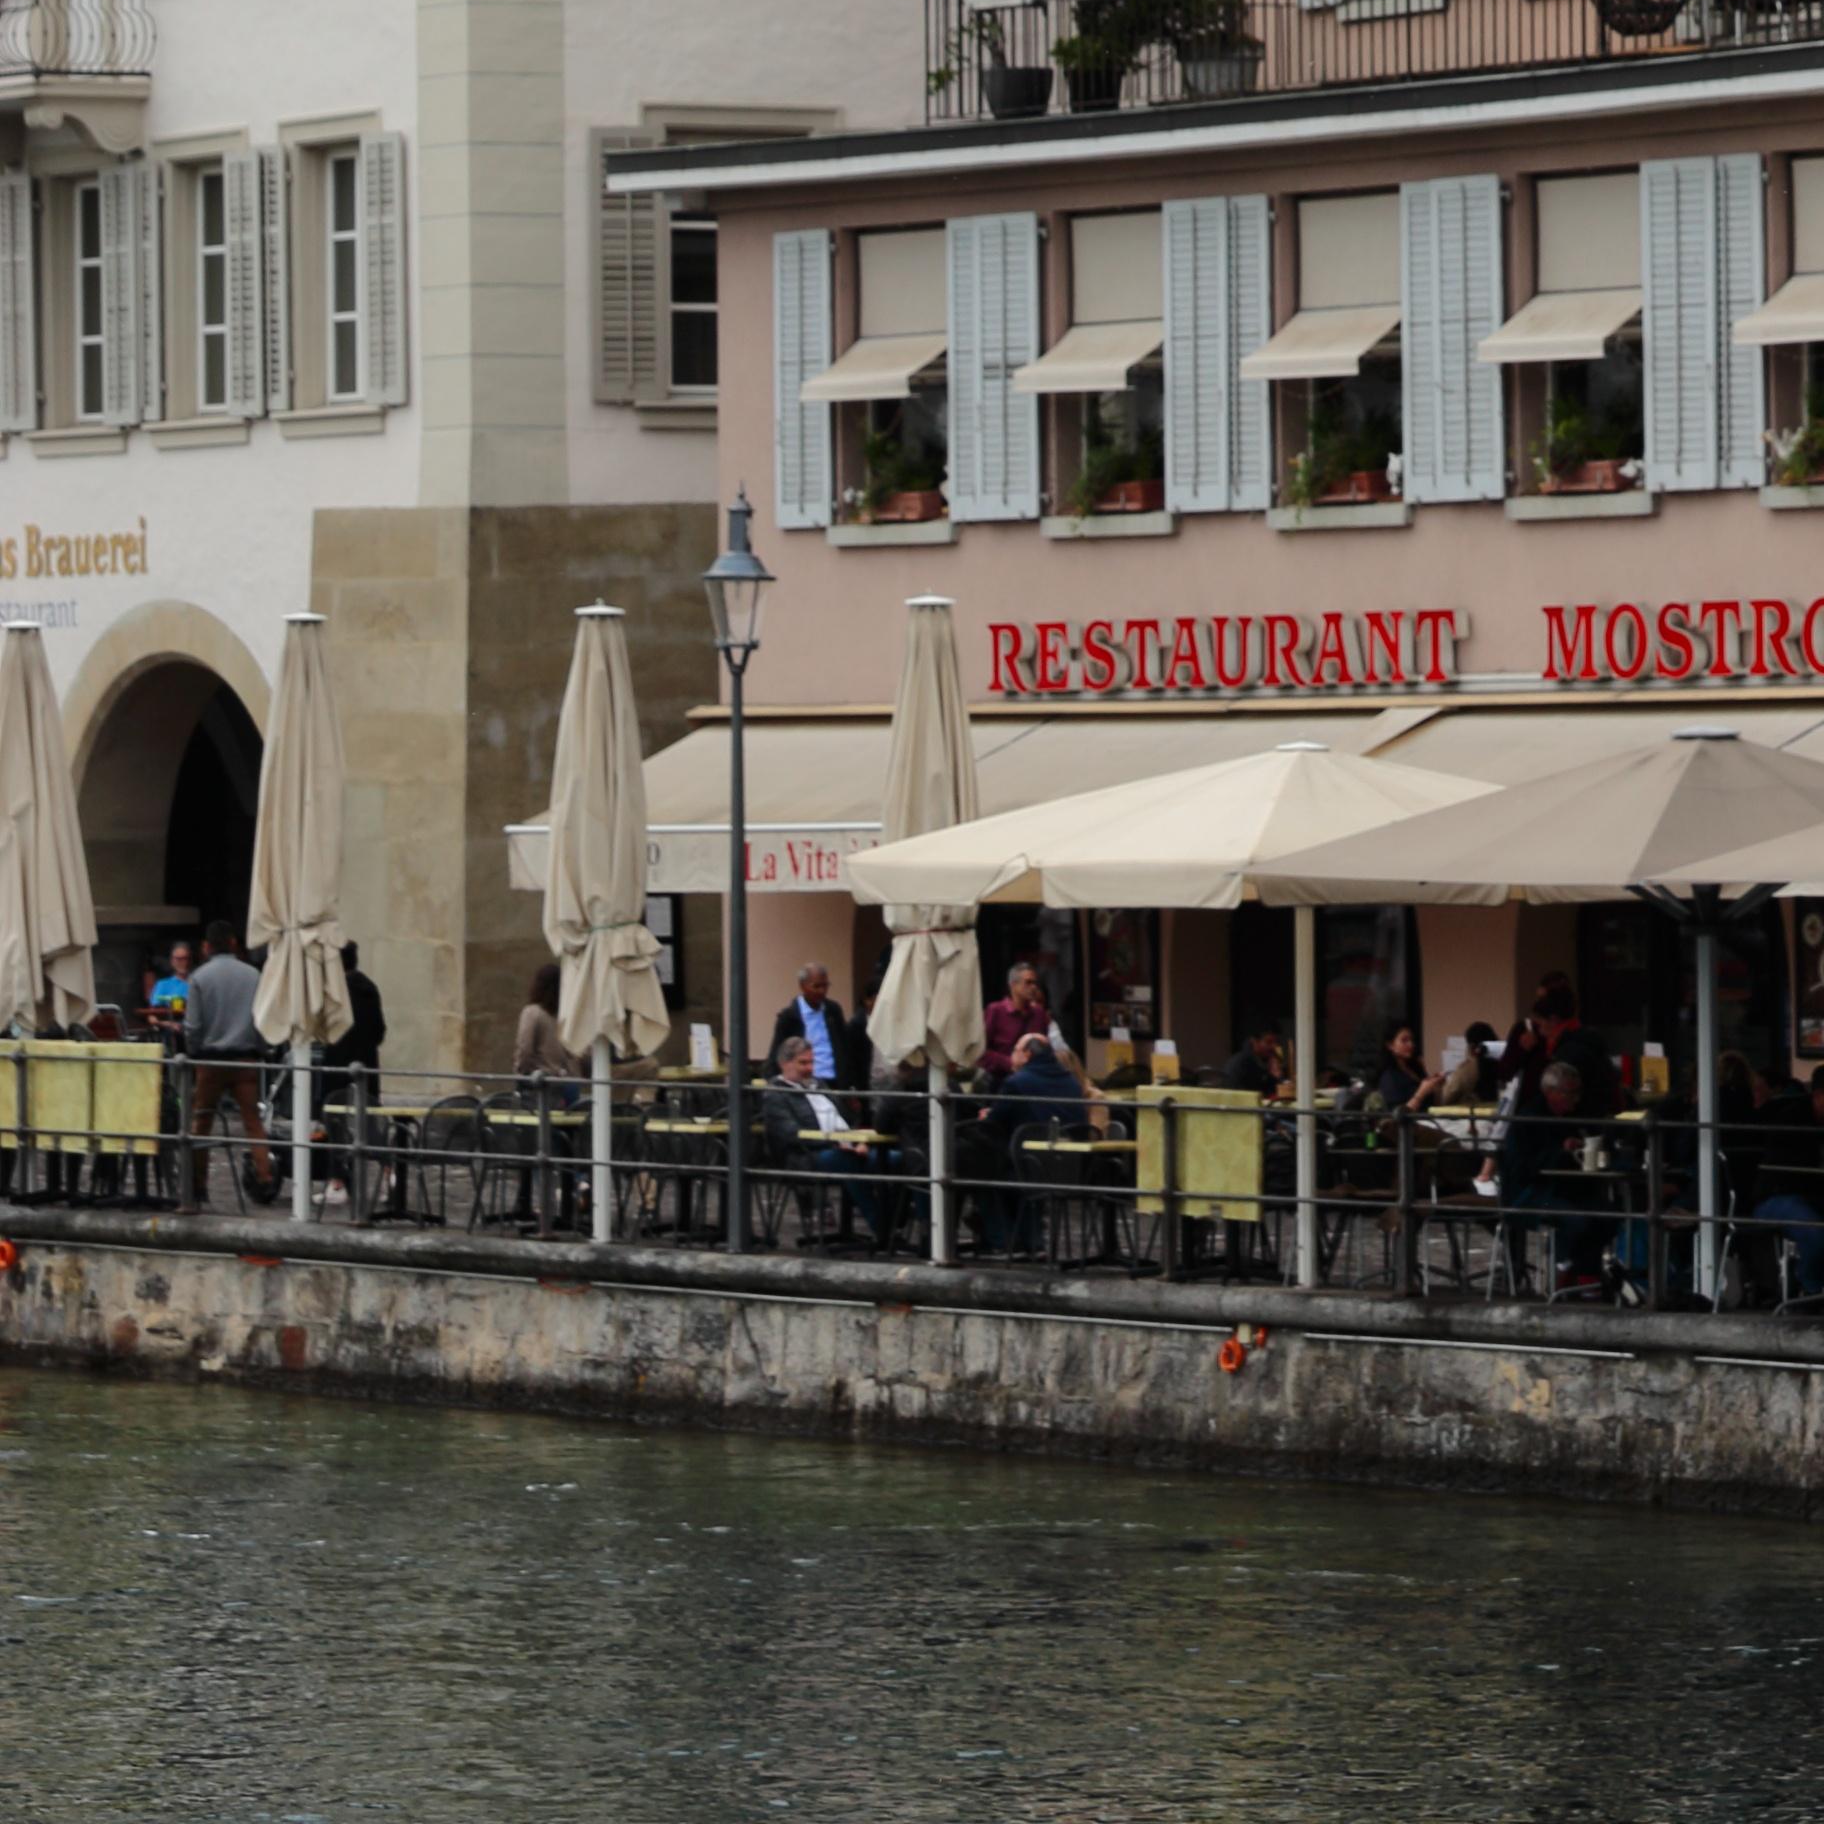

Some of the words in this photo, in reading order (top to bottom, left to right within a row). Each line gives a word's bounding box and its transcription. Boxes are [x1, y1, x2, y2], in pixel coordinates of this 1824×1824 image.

[25, 514, 148, 578] Brauerei
[987, 610, 1459, 694] RESTAURANT
[743, 840, 777, 882] La
[786, 840, 839, 882] Vita
